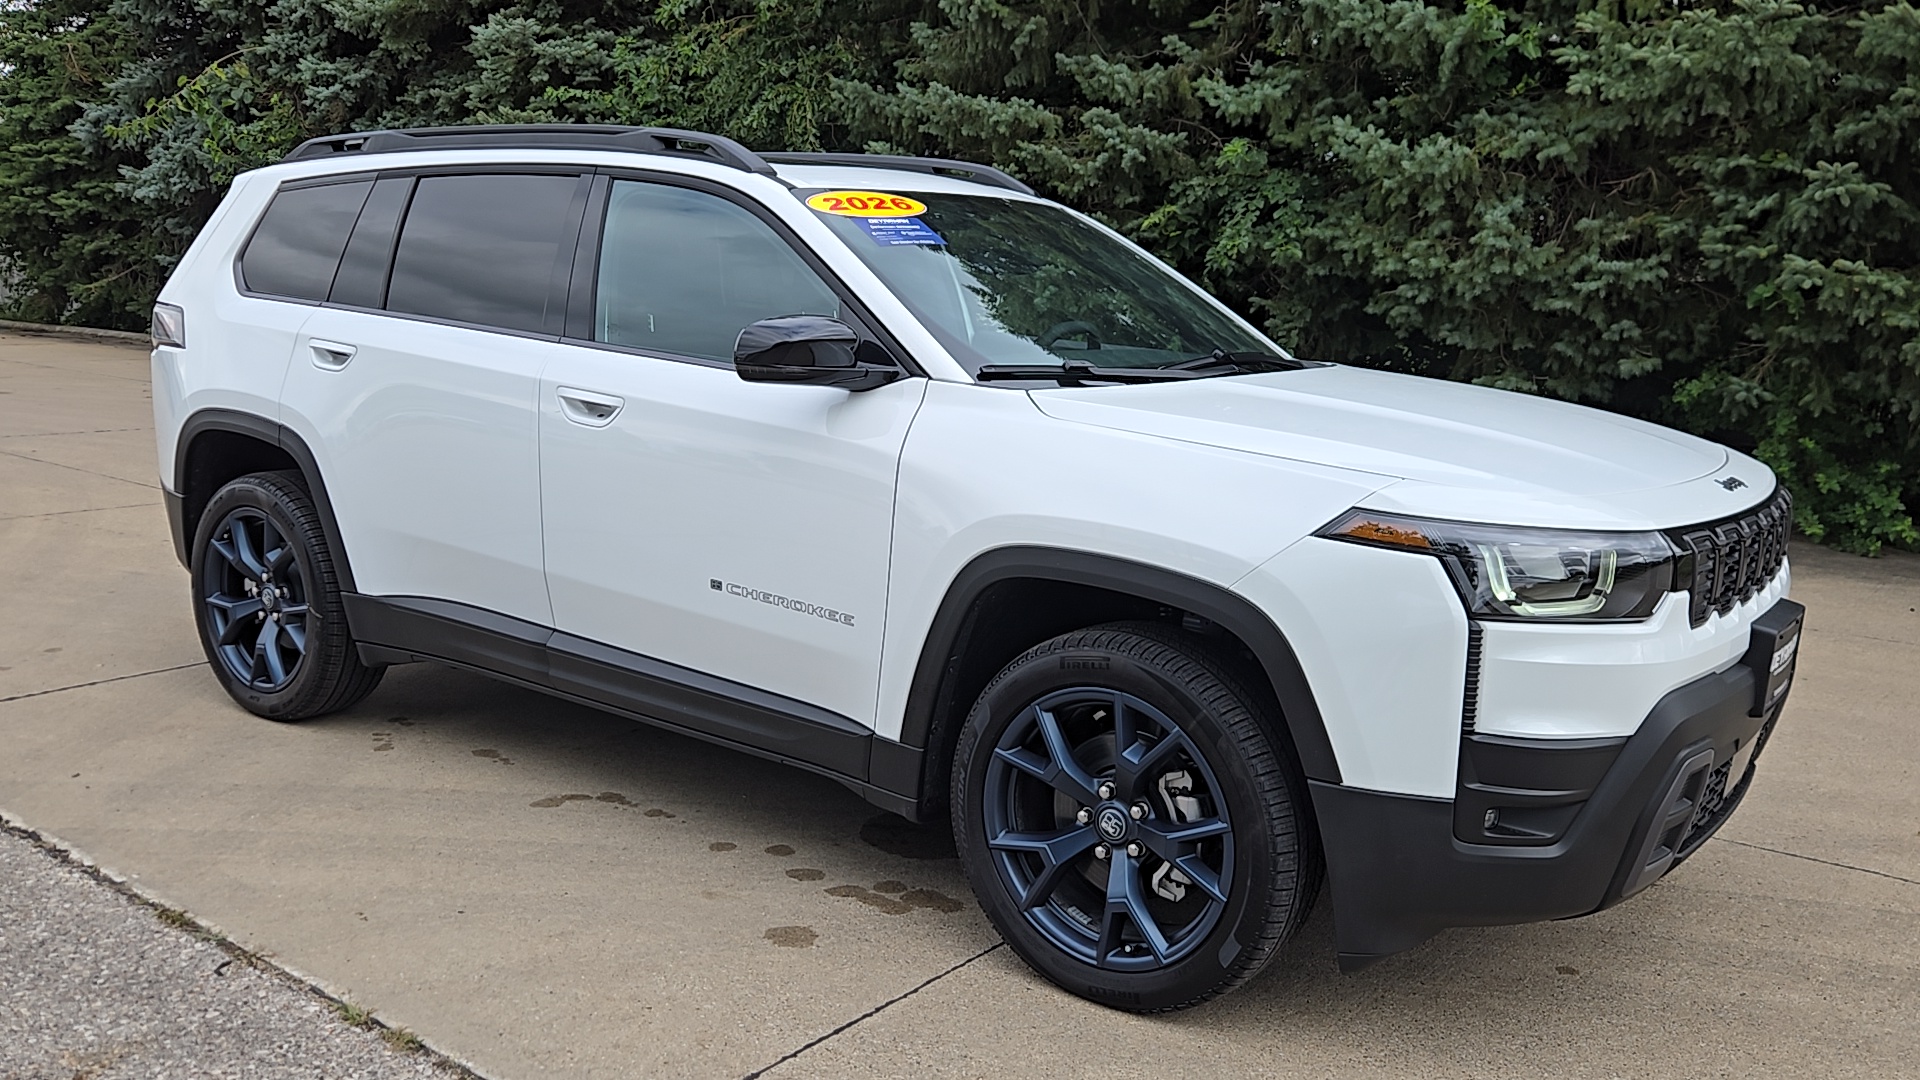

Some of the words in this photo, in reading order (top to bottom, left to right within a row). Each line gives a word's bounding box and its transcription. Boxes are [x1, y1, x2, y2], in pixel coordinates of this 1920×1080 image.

[822, 197, 914, 211] 2026
[726, 582, 855, 627] CHEROKEE
[1060, 655, 1111, 670] PIRELLI
